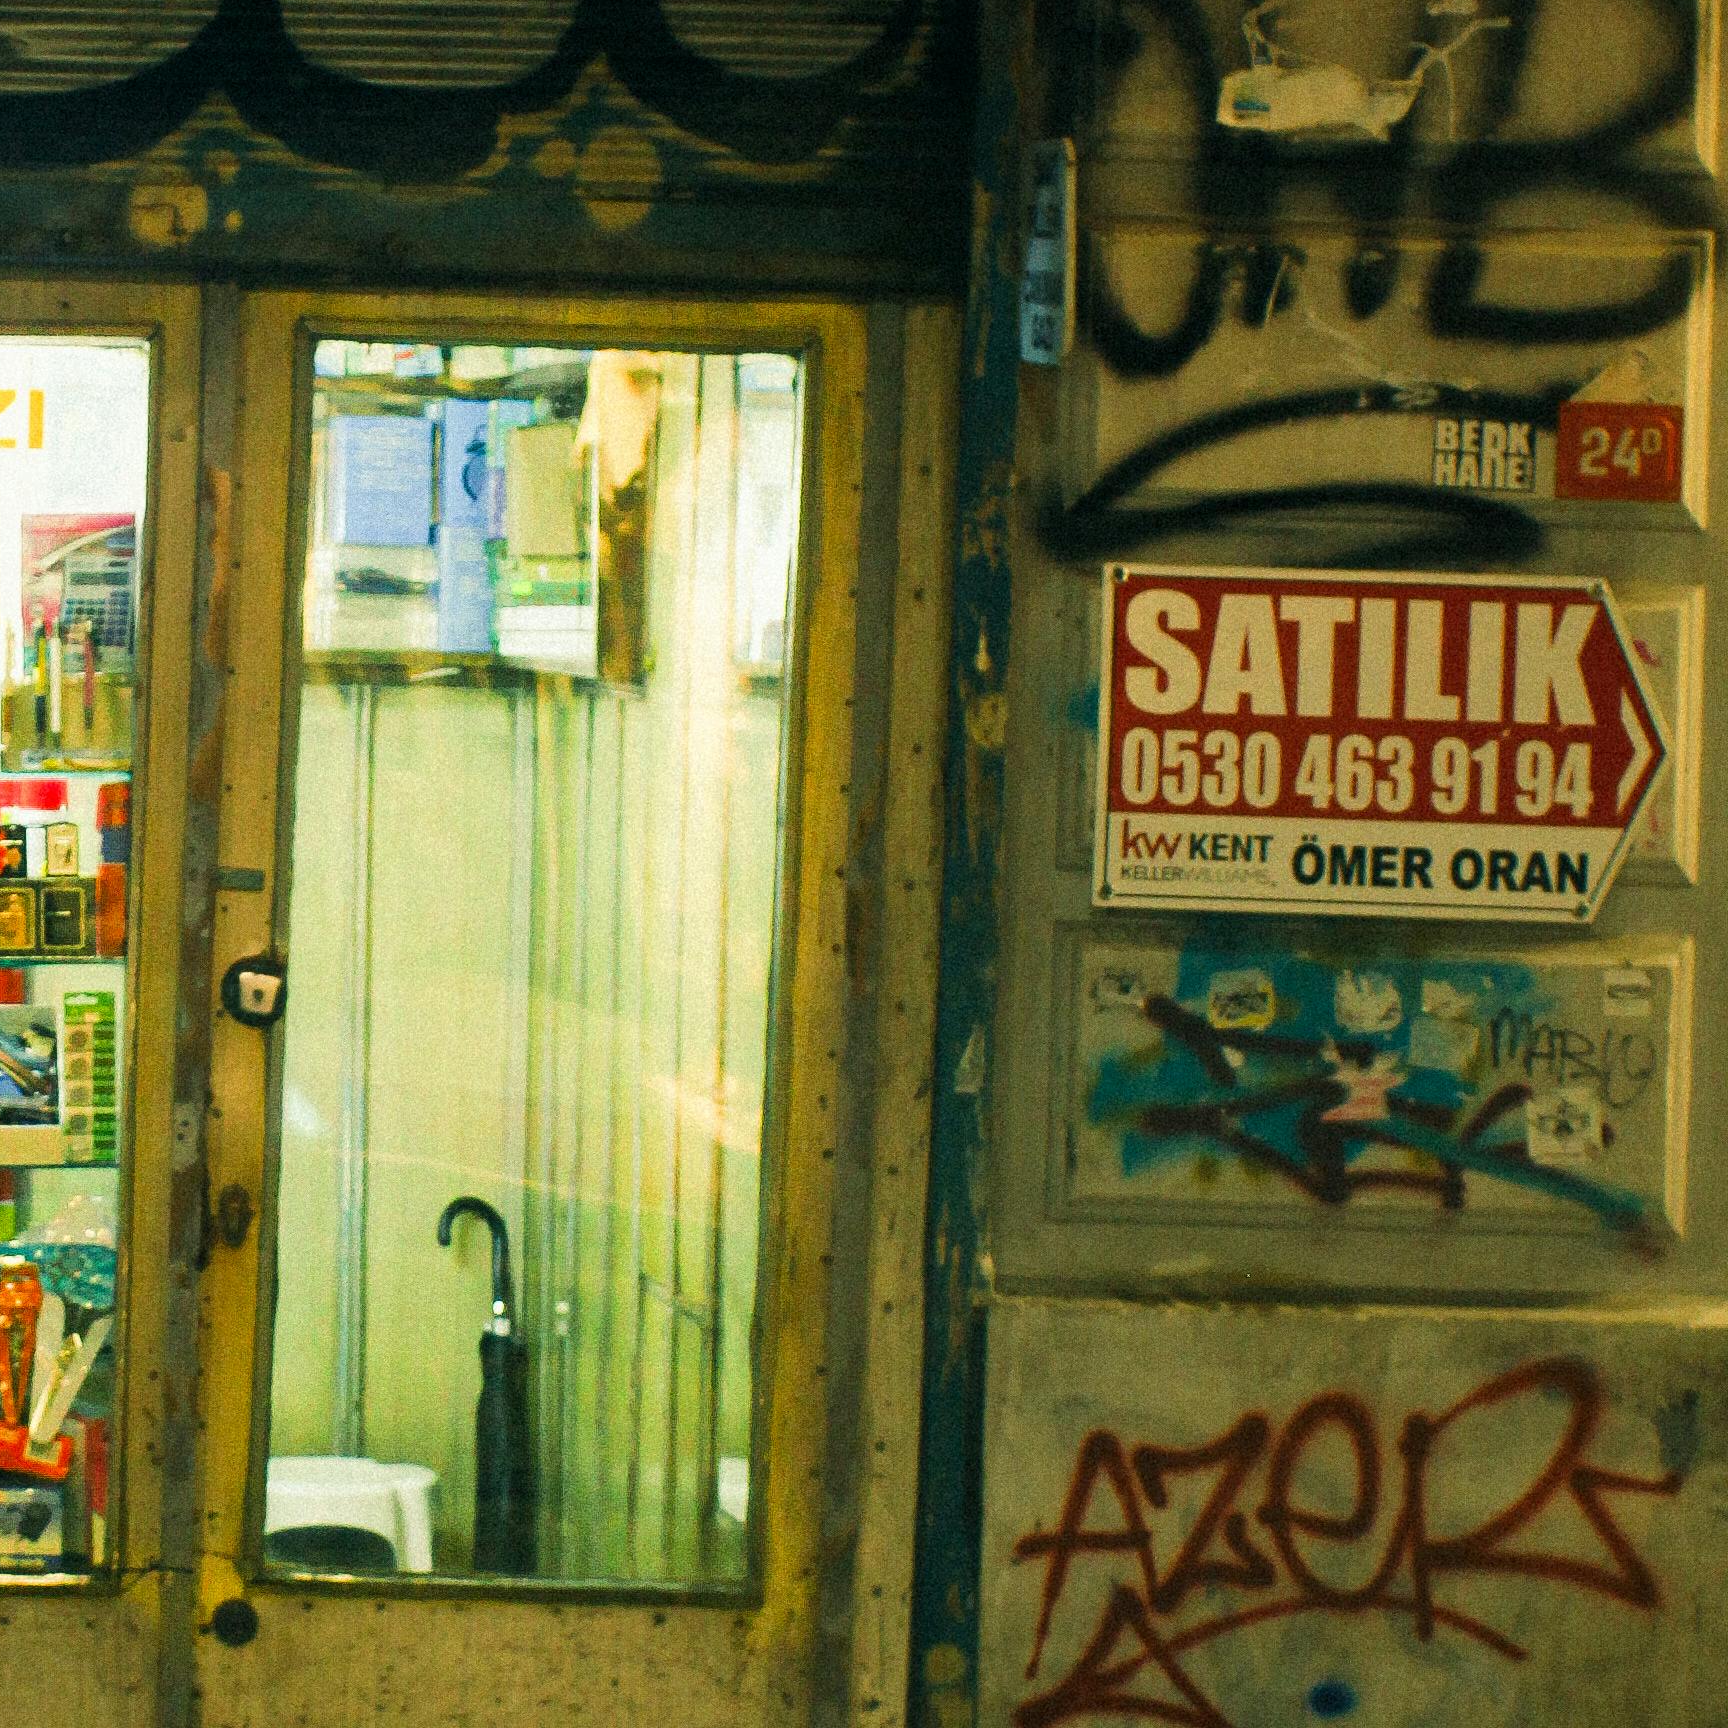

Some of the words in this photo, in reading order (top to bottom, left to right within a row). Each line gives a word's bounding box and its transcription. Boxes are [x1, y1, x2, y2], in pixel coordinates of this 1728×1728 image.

[1124, 587, 1598, 727] SATILIK
[1120, 727, 1282, 809] 0530
[1295, 733, 1414, 813] 463
[1431, 737, 1500, 815] 91
[1515, 740, 1594, 818] 94
[1189, 833, 1274, 863] KENT
[1291, 835, 1433, 889] ÖMER
[1450, 848, 1589, 895] ORAN
